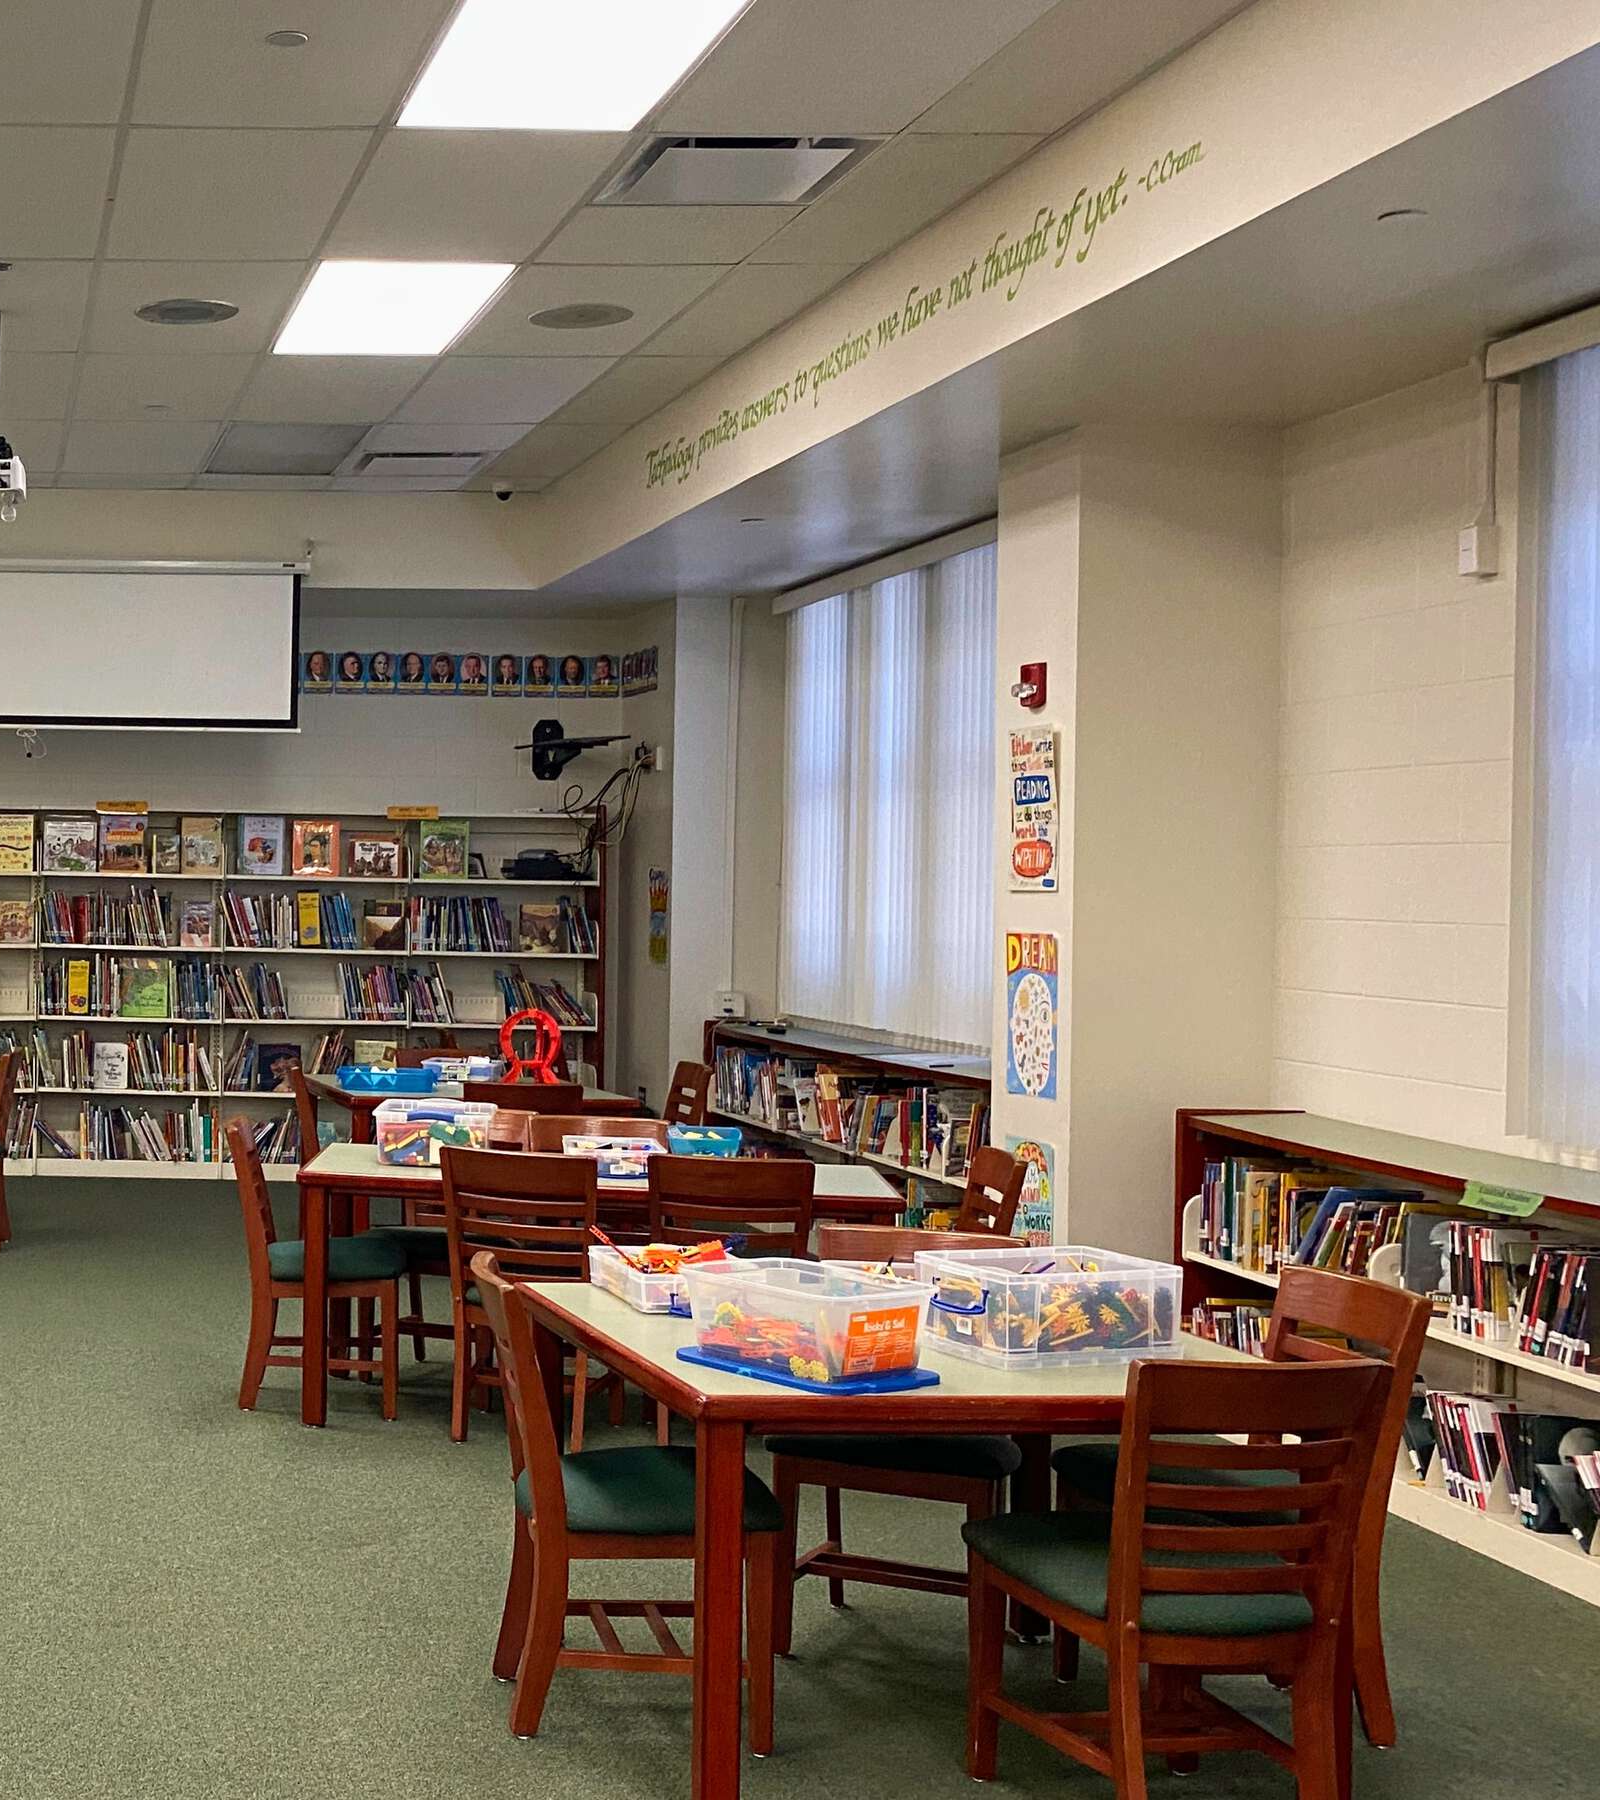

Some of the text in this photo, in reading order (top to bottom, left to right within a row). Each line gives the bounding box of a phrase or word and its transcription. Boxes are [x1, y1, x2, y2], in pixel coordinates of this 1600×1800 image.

[645, 436, 695, 489] Technology
[696, 410, 739, 471] provides
[741, 381, 790, 432] answers
[794, 369, 808, 403] to
[808, 328, 872, 408] questions
[877, 311, 899, 349] we
[902, 286, 943, 336] have
[948, 258, 977, 310] not
[982, 206, 1056, 301] thought
[1055, 187, 1087, 268] of
[1076, 167, 1128, 263] yet.
[1016, 779, 1049, 801] READING
[1024, 806, 1033, 821] do
[1034, 807, 1052, 825] things
[1038, 824, 1048, 837] the
[1015, 847, 1050, 869] WRITING
[1007, 934, 1056, 972] DREAM
[1024, 1213, 1052, 1232] WORKS
